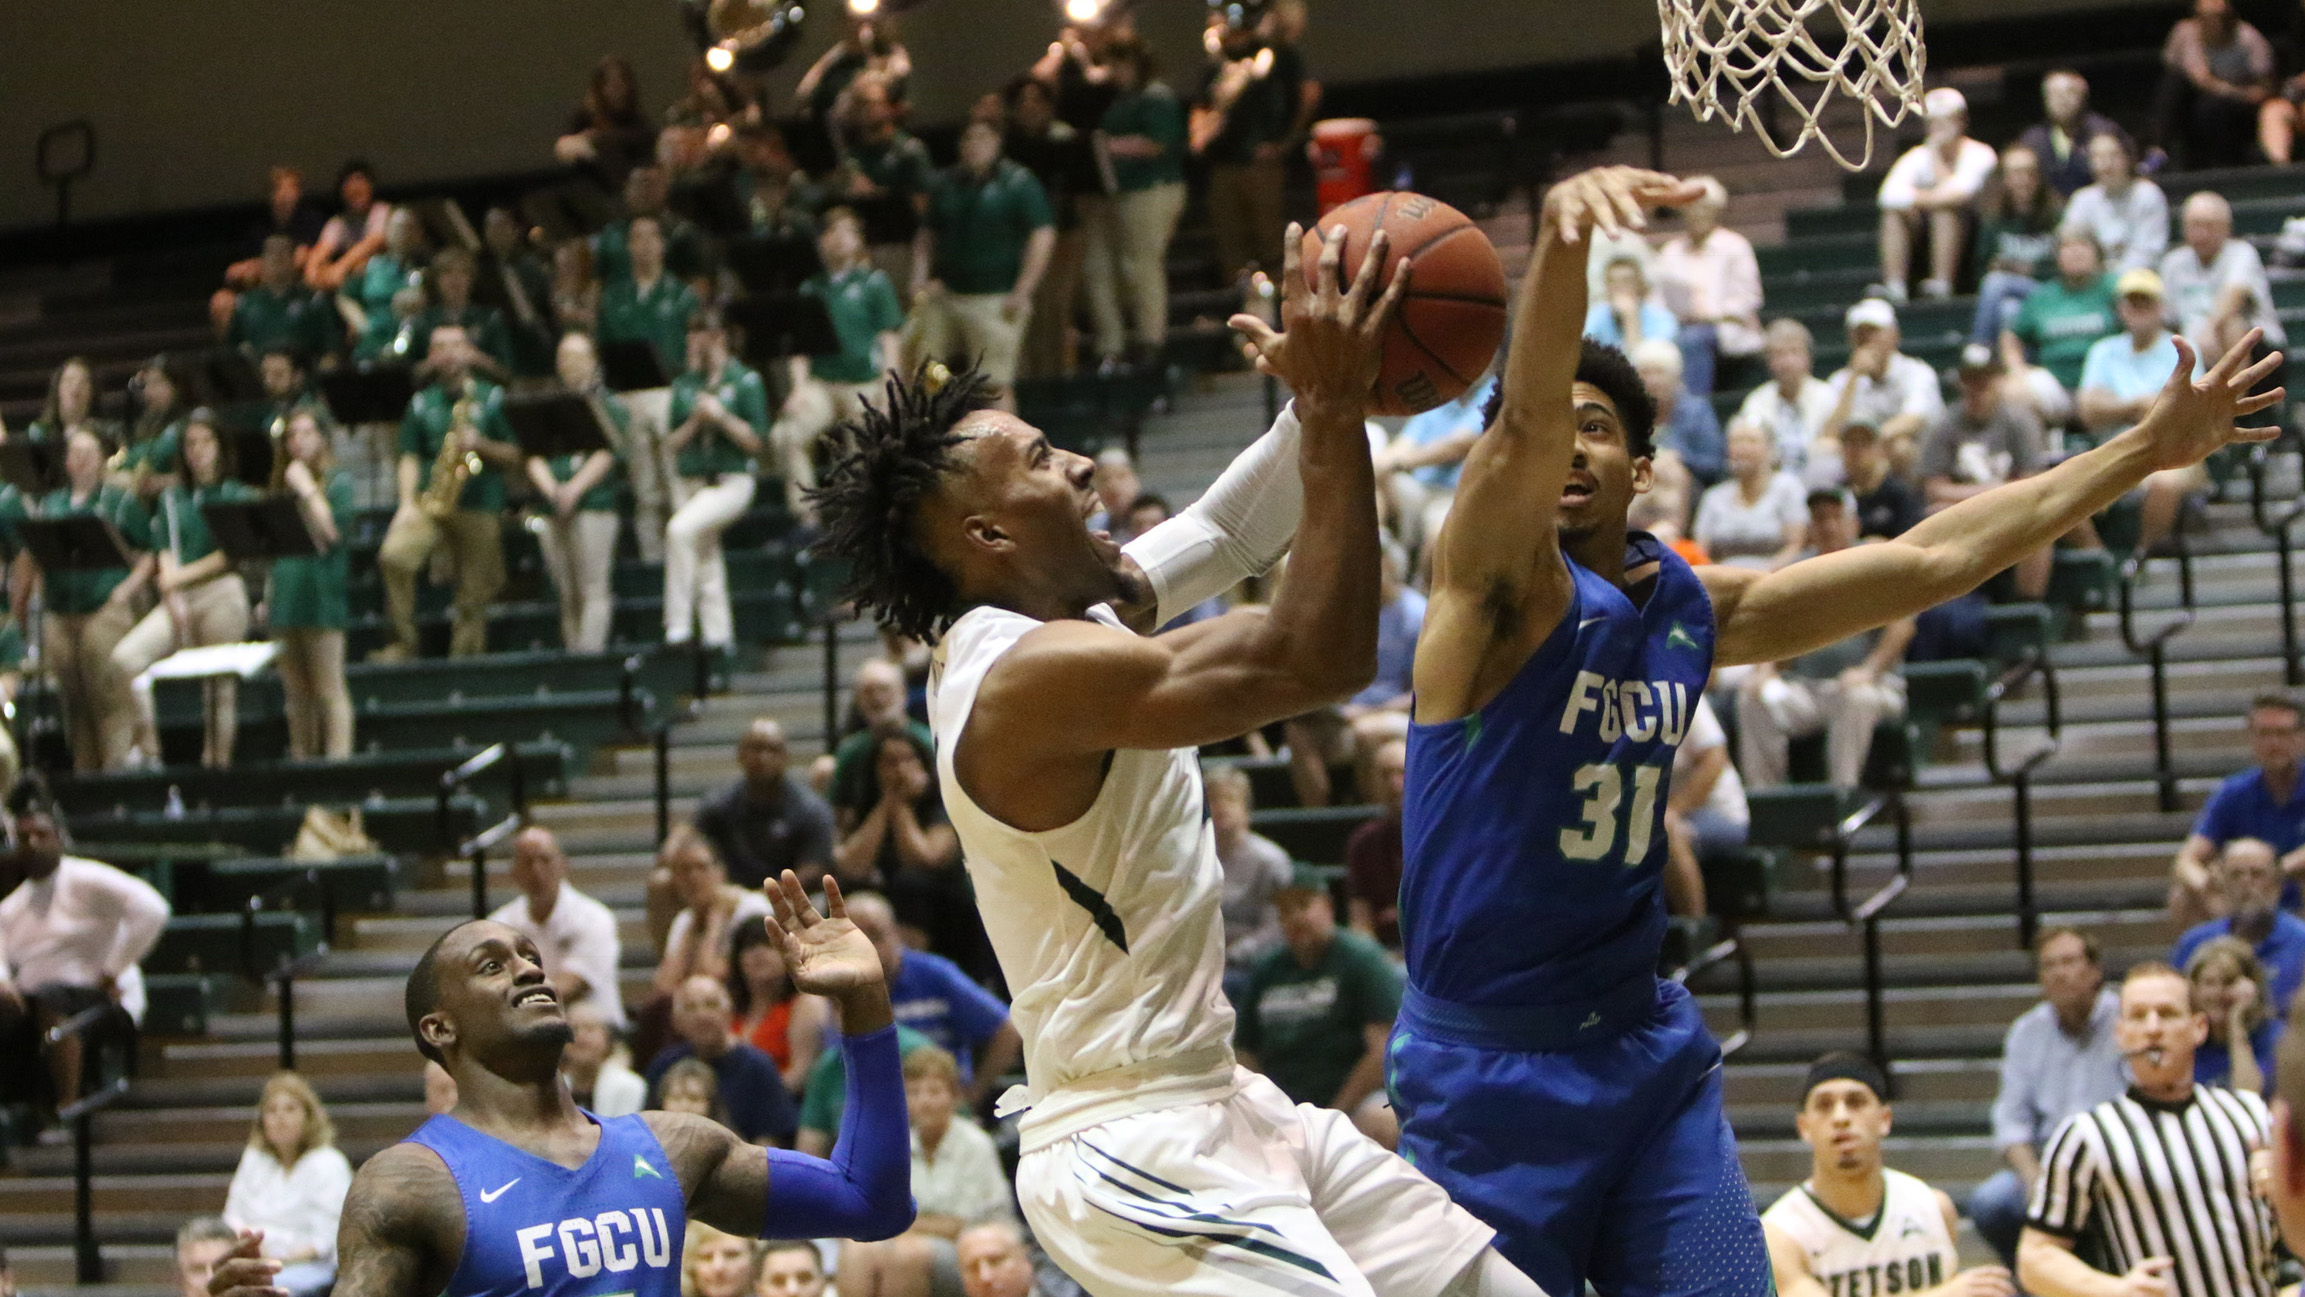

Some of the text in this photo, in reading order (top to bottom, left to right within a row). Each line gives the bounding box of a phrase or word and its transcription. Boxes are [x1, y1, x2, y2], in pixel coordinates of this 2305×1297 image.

[1559, 670, 1687, 746] FGCU
[1559, 763, 1662, 866] 31
[516, 1208, 670, 1289] FGCU
[1814, 1252, 1942, 1297] TETSON
